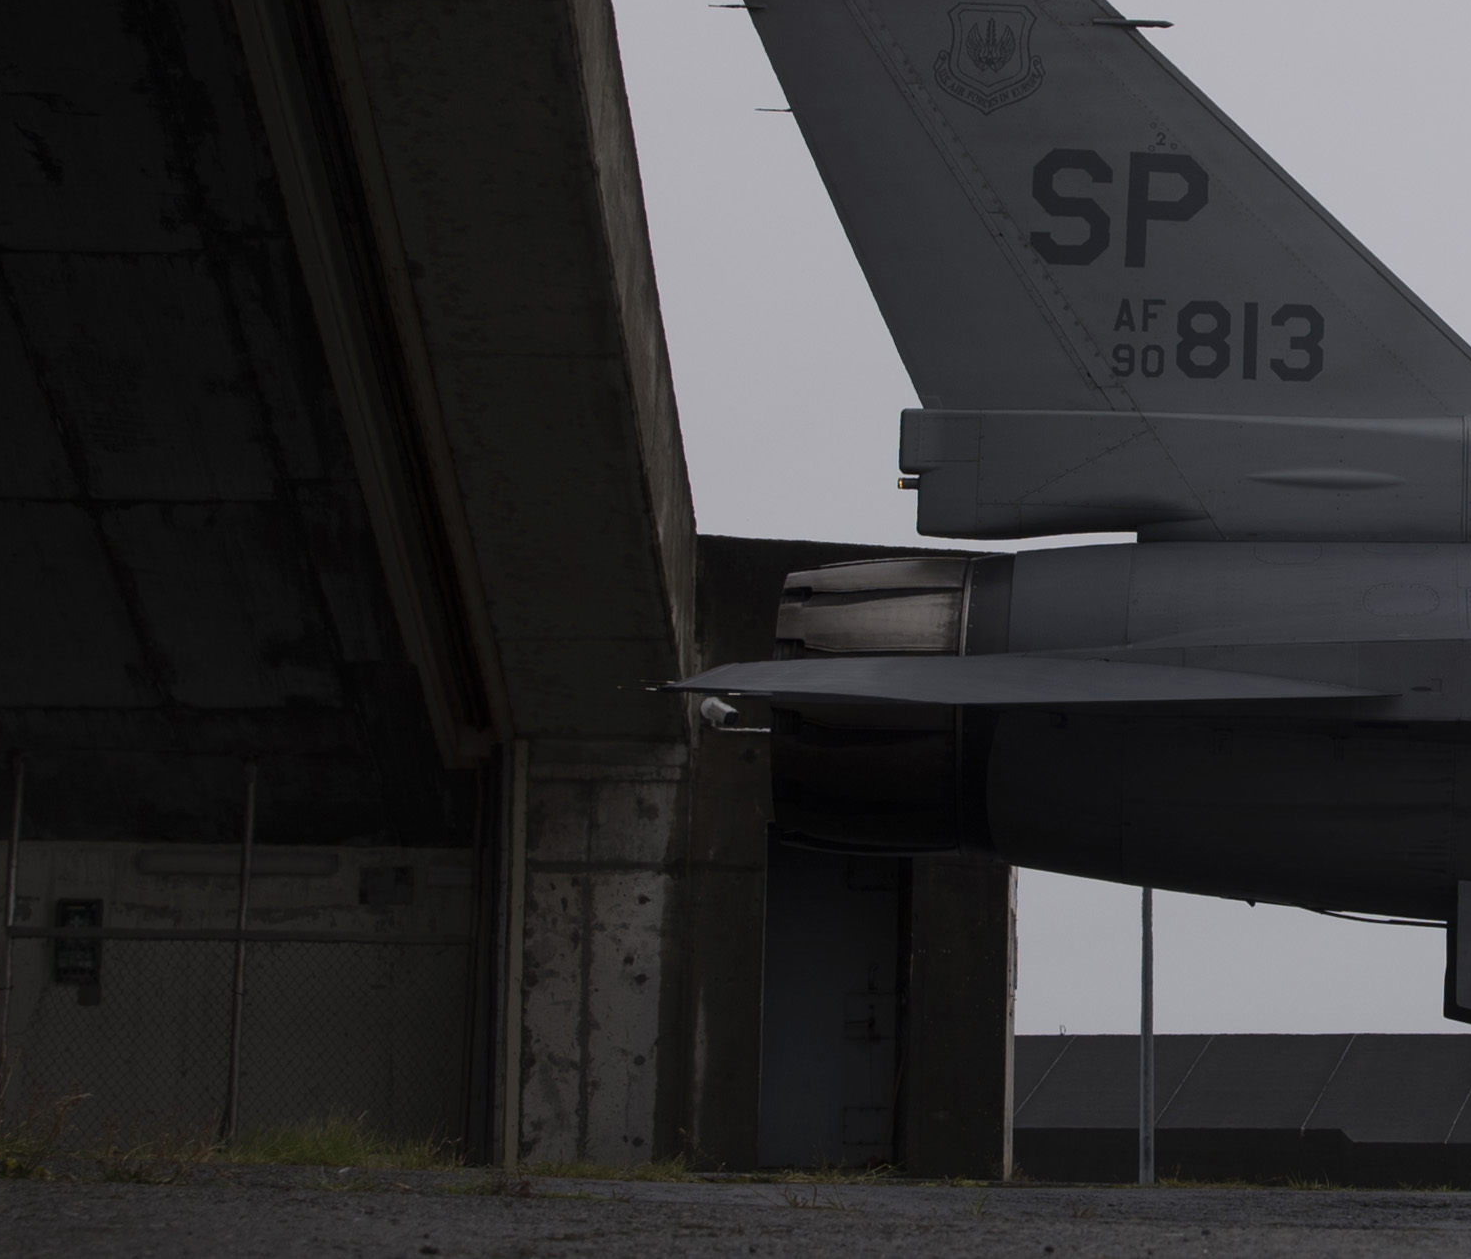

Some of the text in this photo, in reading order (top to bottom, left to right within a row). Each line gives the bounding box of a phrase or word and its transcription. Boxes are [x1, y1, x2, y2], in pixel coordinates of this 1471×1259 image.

[949, 82, 966, 97] AIR
[999, 92, 1010, 103] IN
[1155, 132, 1168, 146] 2
[1030, 148, 1209, 268] SP
[1113, 298, 1167, 332] AF
[1176, 300, 1325, 382] 813
[1111, 343, 1165, 378] 90
